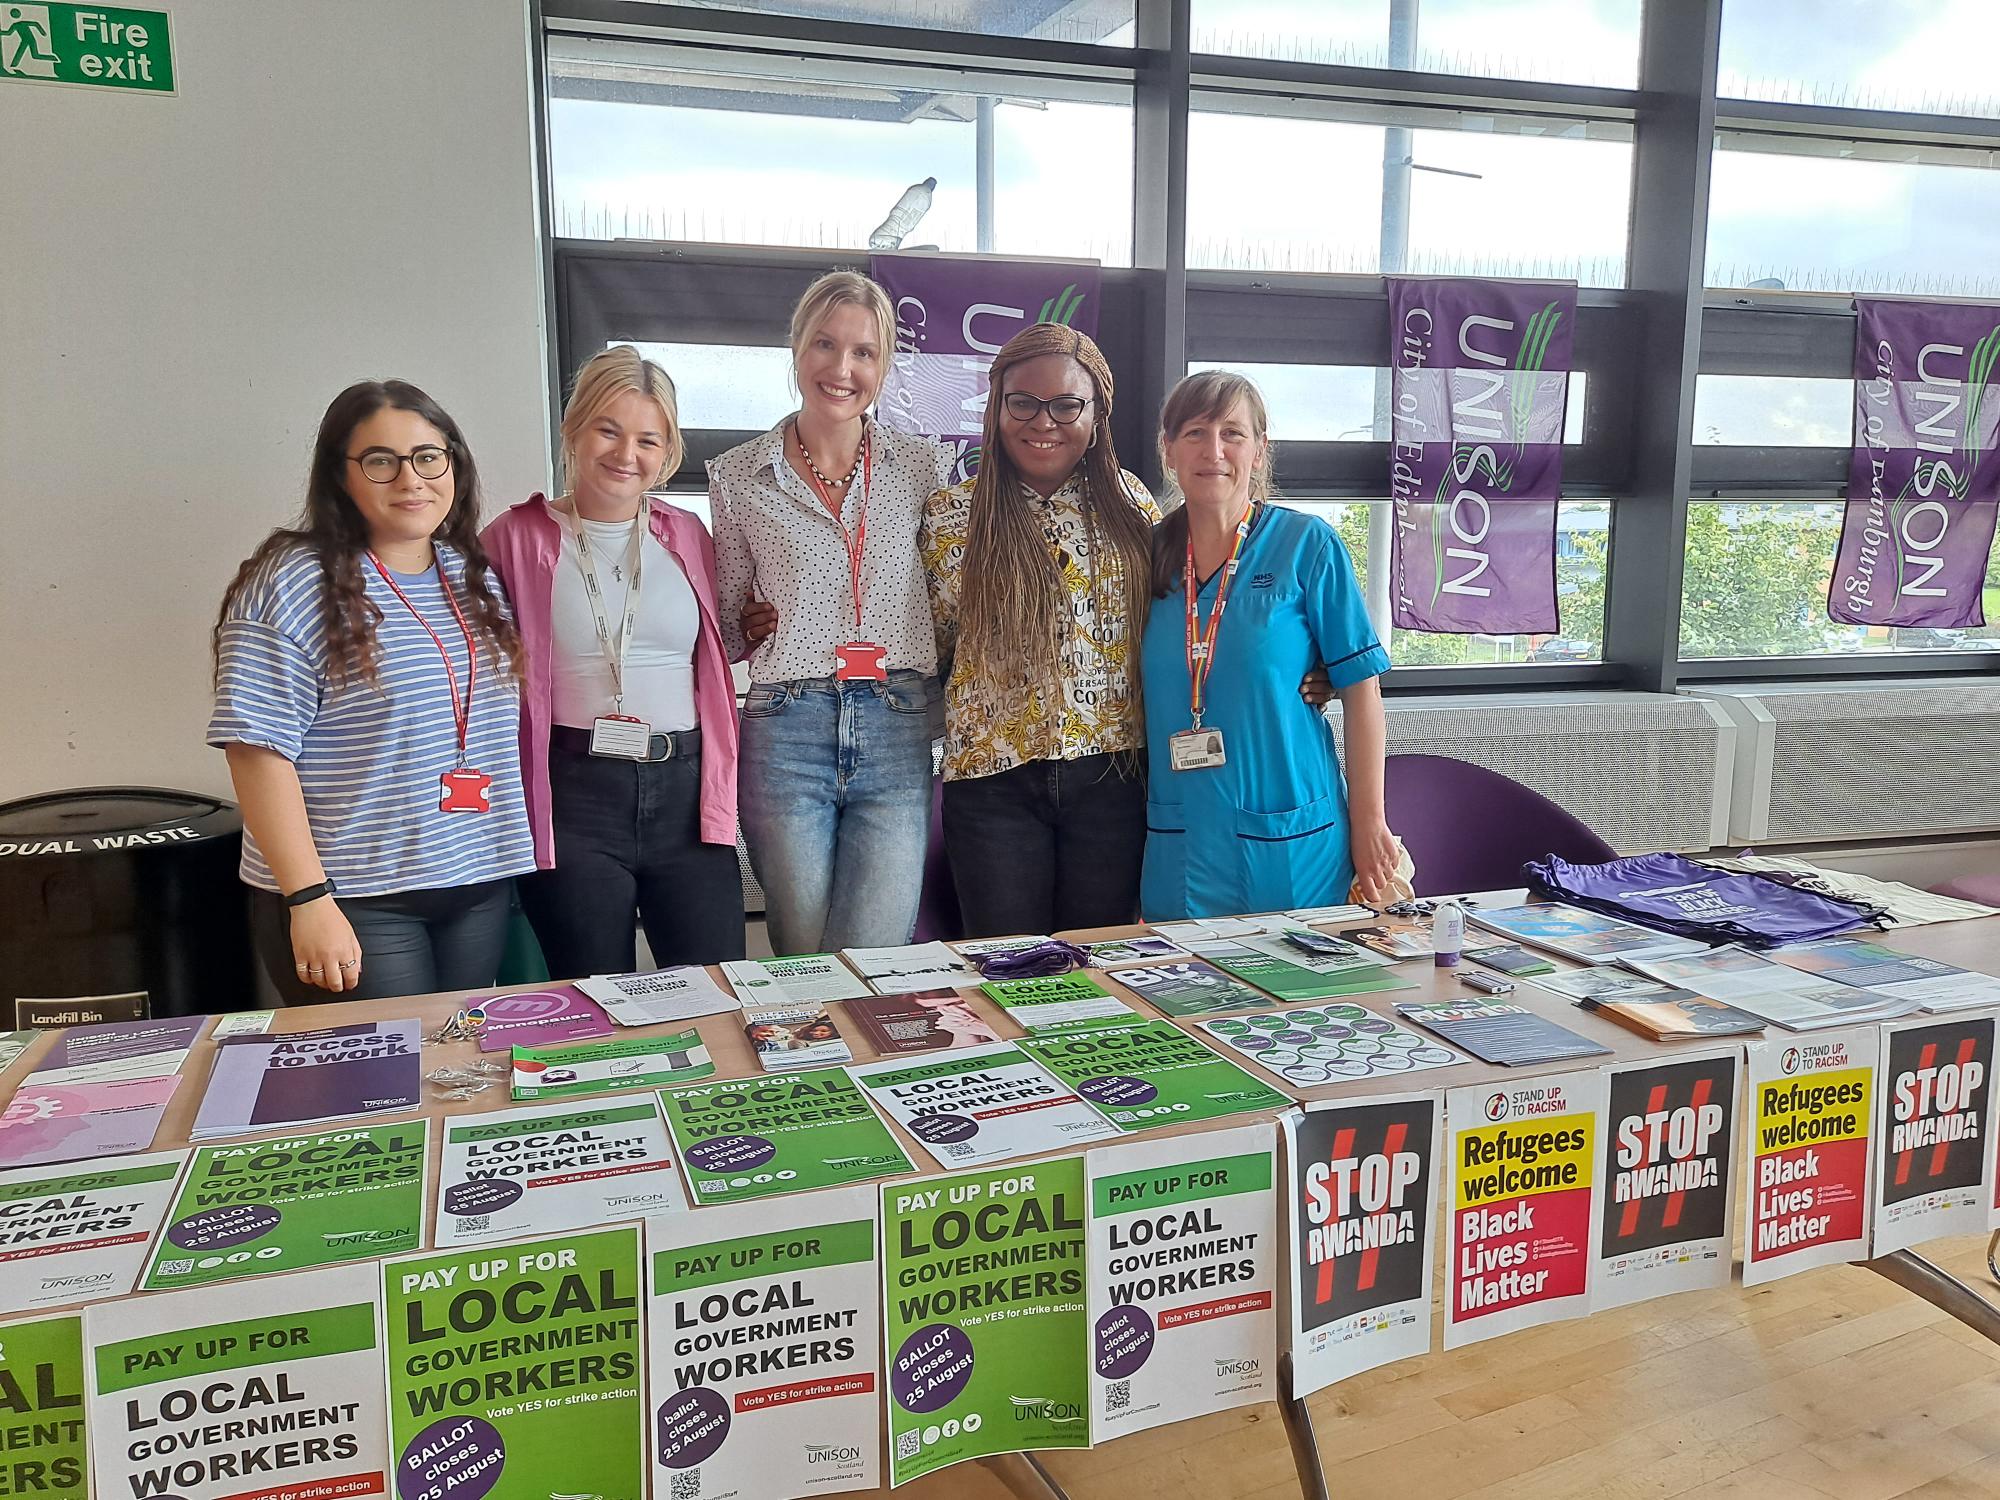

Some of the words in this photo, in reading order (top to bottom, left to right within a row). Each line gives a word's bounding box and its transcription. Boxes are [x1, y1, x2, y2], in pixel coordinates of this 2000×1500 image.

[75, 11, 149, 48] Fire
[79, 50, 153, 82] exit
[1396, 308, 1433, 382] City
[1866, 340, 1896, 406] City
[889, 388, 924, 433] of
[1393, 393, 1427, 433] of
[1863, 418, 1889, 453] of
[1441, 315, 1514, 597] UNISON
[1901, 344, 1964, 597] UNISON
[1253, 572, 1274, 581] NHS
[0, 840, 82, 857] DUAL
[92, 826, 200, 850] WASTE
[999, 982, 1089, 995] LOCAL
[1006, 988, 1093, 999] GOVERNMENT
[1010, 993, 1100, 1005] WORKERS
[31, 1013, 78, 1025] Landfill
[81, 1011, 103, 1022] Bin
[487, 1013, 592, 1031] Menopause
[268, 1056, 306, 1068] to
[314, 1043, 409, 1064] work
[270, 1033, 404, 1055] Access
[1036, 1029, 1189, 1059] LOCAL
[1053, 1040, 1201, 1068] GOVERNMENT
[1802, 1058, 1813, 1070] TO
[1815, 1054, 1848, 1069] RACISM
[1803, 1044, 1831, 1058] STAND
[1832, 1043, 1845, 1054] UP
[1061, 1050, 1216, 1079] WORKERS
[362, 1096, 407, 1108] UNISON
[677, 1080, 856, 1114] LOCAL
[890, 1073, 1003, 1098] LOCAL
[901, 1076, 1043, 1107] GOVERNMENT
[910, 1086, 1056, 1117] WORKERS
[1083, 1076, 1122, 1094] BALLOT
[1513, 1091, 1545, 1105] STAND
[1547, 1086, 1562, 1100] UP
[1763, 1082, 1863, 1118] Refugees
[1894, 1061, 1984, 1122] STOP
[470, 1126, 512, 1138] PAY
[522, 1120, 553, 1131] UP
[561, 1114, 607, 1126] FOR
[682, 1093, 863, 1125] GOVERNMENT
[687, 1104, 869, 1138] WORKERS
[1512, 1104, 1525, 1117] TO
[1527, 1099, 1567, 1116] RACISM
[211, 1145, 265, 1159] PAY
[273, 1140, 309, 1151] UP
[317, 1131, 371, 1145] FOR
[467, 1130, 604, 1157] LOCAL
[1464, 1128, 1585, 1168] Refugees
[1617, 1104, 1723, 1170] STOP
[1762, 1112, 1857, 1150] welcome
[1892, 1111, 1978, 1155] RWANDA
[208, 1137, 423, 1177] LOCAL
[465, 1148, 648, 1181] WORKERS
[466, 1136, 647, 1167] GOVERNMENT
[1760, 1149, 1820, 1189] Black
[196, 1165, 419, 1206] WORKERS
[200, 1152, 423, 1190] GOVERNMENT
[1109, 1182, 1147, 1203] PAY
[1154, 1177, 1181, 1194] UP
[1188, 1170, 1229, 1190] FOR
[1306, 1152, 1421, 1224] STOP
[1463, 1162, 1578, 1202] welcome
[1615, 1158, 1719, 1204] RWANDA
[0, 1195, 96, 1217] CAL
[897, 1189, 942, 1214] PAY
[948, 1184, 981, 1203] UP
[988, 1175, 1035, 1198] FOR
[1759, 1186, 1814, 1221] Lives
[0, 1203, 144, 1230] ERNMENT
[183, 1206, 255, 1230] BALLOT
[900, 1194, 1082, 1259] LOCAL
[1109, 1208, 1222, 1250] LOCAL
[1462, 1200, 1535, 1245] Black
[1758, 1213, 1831, 1252] Matter
[1108, 1234, 1258, 1275] GOVERNMENT
[1308, 1210, 1415, 1266] RWANDA
[402, 1266, 459, 1295] PAY
[469, 1258, 509, 1281] UP
[519, 1249, 577, 1274] FOR
[674, 1254, 721, 1278] PAY
[730, 1248, 763, 1268] UP
[772, 1239, 821, 1262] FOR
[899, 1240, 1084, 1287] GOVERNMENT
[1461, 1241, 1528, 1278] Lives
[899, 1269, 1082, 1325] WORKERS
[1108, 1259, 1255, 1306] WORKERS
[1460, 1268, 1549, 1313] Matter
[406, 1269, 636, 1345] LOCAL
[674, 1281, 815, 1330] LOCAL
[960, 1315, 982, 1327] Vote
[984, 1311, 1005, 1322] YES
[1006, 1309, 1021, 1319] for
[1023, 1305, 1051, 1316] strike
[1053, 1302, 1084, 1313] action
[1164, 1314, 1183, 1325] Vote
[1183, 1310, 1201, 1320] YES
[1201, 1308, 1213, 1317] for
[1214, 1303, 1237, 1314] strike
[1237, 1298, 1262, 1310] action
[674, 1309, 857, 1357] GOVERNMENT
[1100, 1315, 1129, 1339] ballot
[1104, 1327, 1136, 1352] closes
[124, 1345, 184, 1374] PAY
[196, 1336, 237, 1360] UP
[249, 1327, 311, 1353] FOR
[405, 1319, 638, 1377] GOVERNMENT
[674, 1337, 855, 1390] WORKERS
[899, 1328, 951, 1372] BALLOT
[912, 1347, 954, 1382] closes
[1099, 1356, 1114, 1370] 25
[1115, 1331, 1150, 1361] August
[406, 1352, 636, 1418] WORKERS
[906, 1389, 925, 1407] 25
[927, 1352, 974, 1392] August
[1217, 1359, 1259, 1377] UNISON
[126, 1373, 305, 1431] LOCAL
[486, 1399, 514, 1419] Vote
[517, 1399, 542, 1413] YES
[544, 1396, 562, 1410] for
[564, 1392, 598, 1407] strike
[600, 1387, 637, 1401] action
[663, 1398, 699, 1425] ballot
[743, 1394, 765, 1407] Vote
[767, 1390, 787, 1402] YES
[788, 1388, 803, 1399] for
[804, 1384, 832, 1397] strike
[834, 1380, 863, 1392] action
[668, 1409, 708, 1440] closes
[1015, 1403, 1081, 1421] UNISON
[128, 1403, 360, 1462] GOVERNMENT
[407, 1419, 475, 1471] BALLOT
[663, 1442, 681, 1460] 25
[683, 1414, 726, 1448] August
[128, 1433, 359, 1500] WORKERS
[424, 1442, 479, 1482] closes
[446, 1447, 505, 1491] August
[808, 1446, 860, 1464] UNISON
[299, 1484, 333, 1499] strike
[335, 1480, 371, 1493] action
